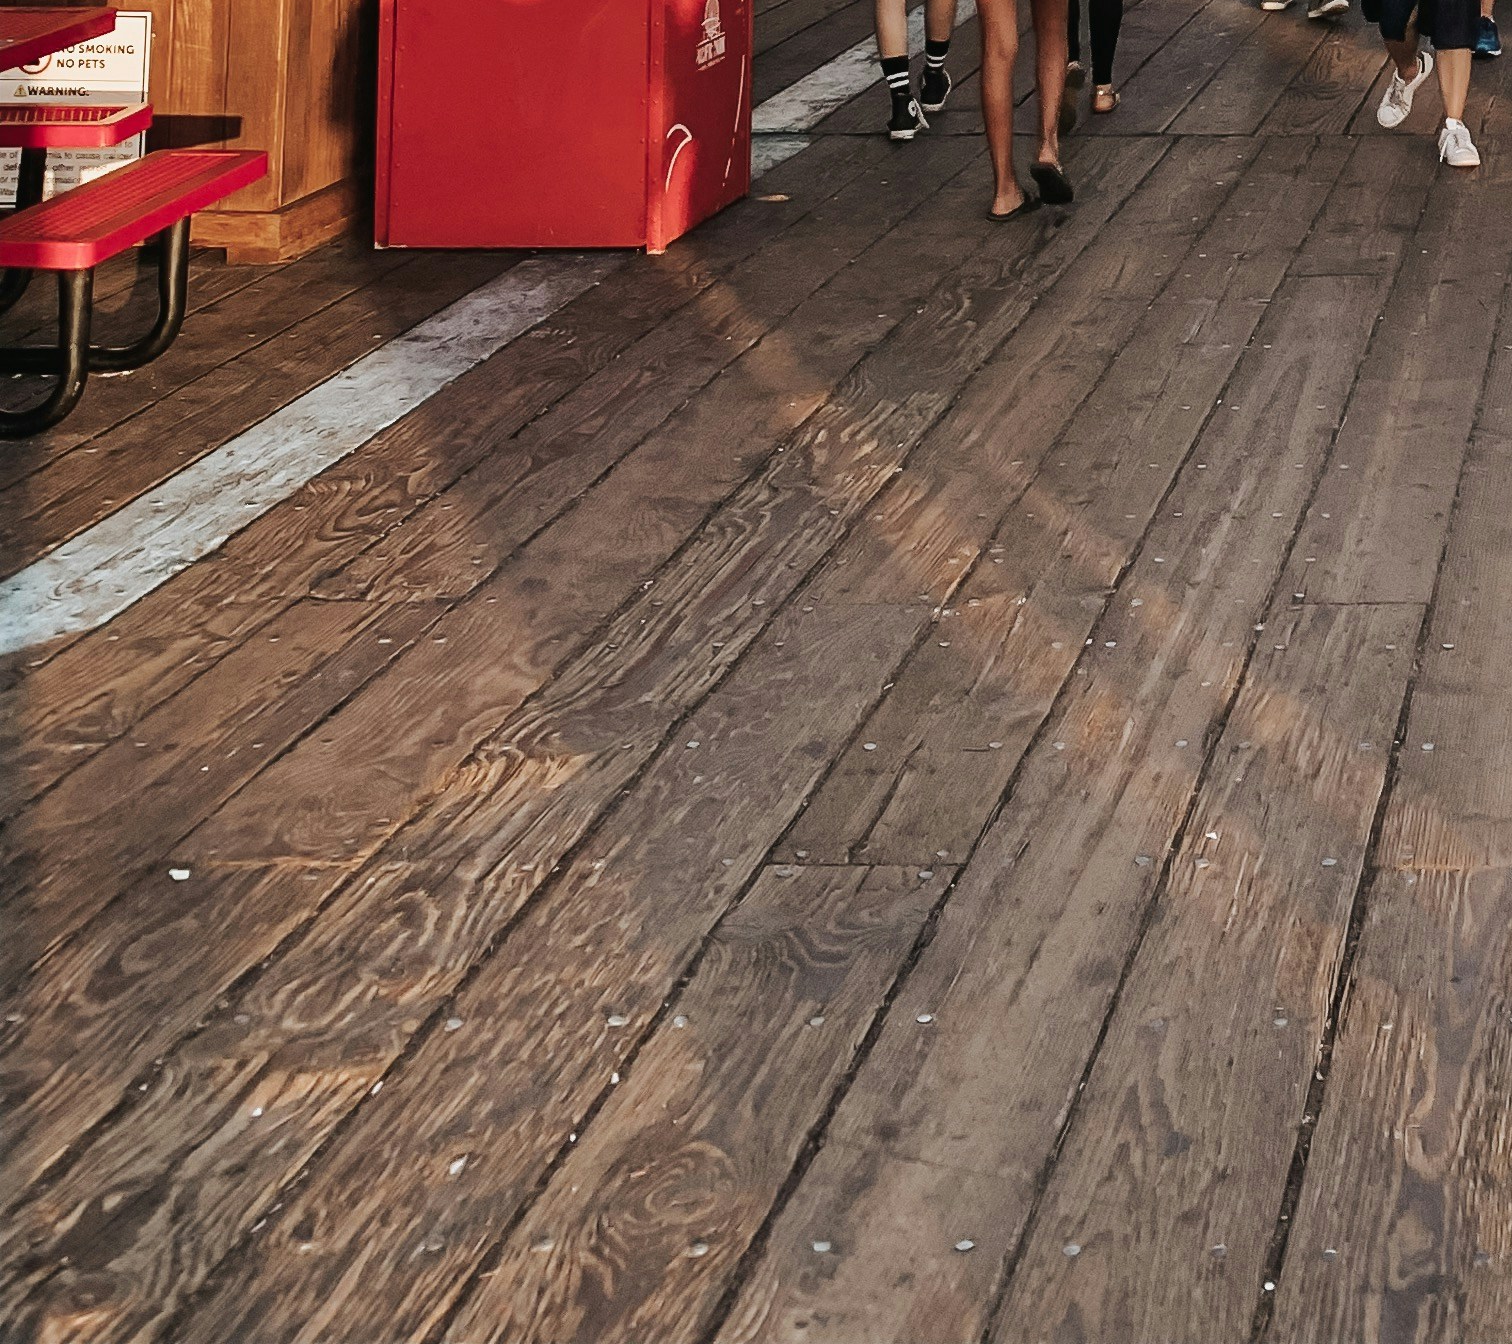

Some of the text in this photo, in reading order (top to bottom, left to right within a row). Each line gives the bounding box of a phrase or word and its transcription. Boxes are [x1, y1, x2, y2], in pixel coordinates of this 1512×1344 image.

[78, 44, 135, 55] SMOKING
[56, 58, 106, 69] NO PETS
